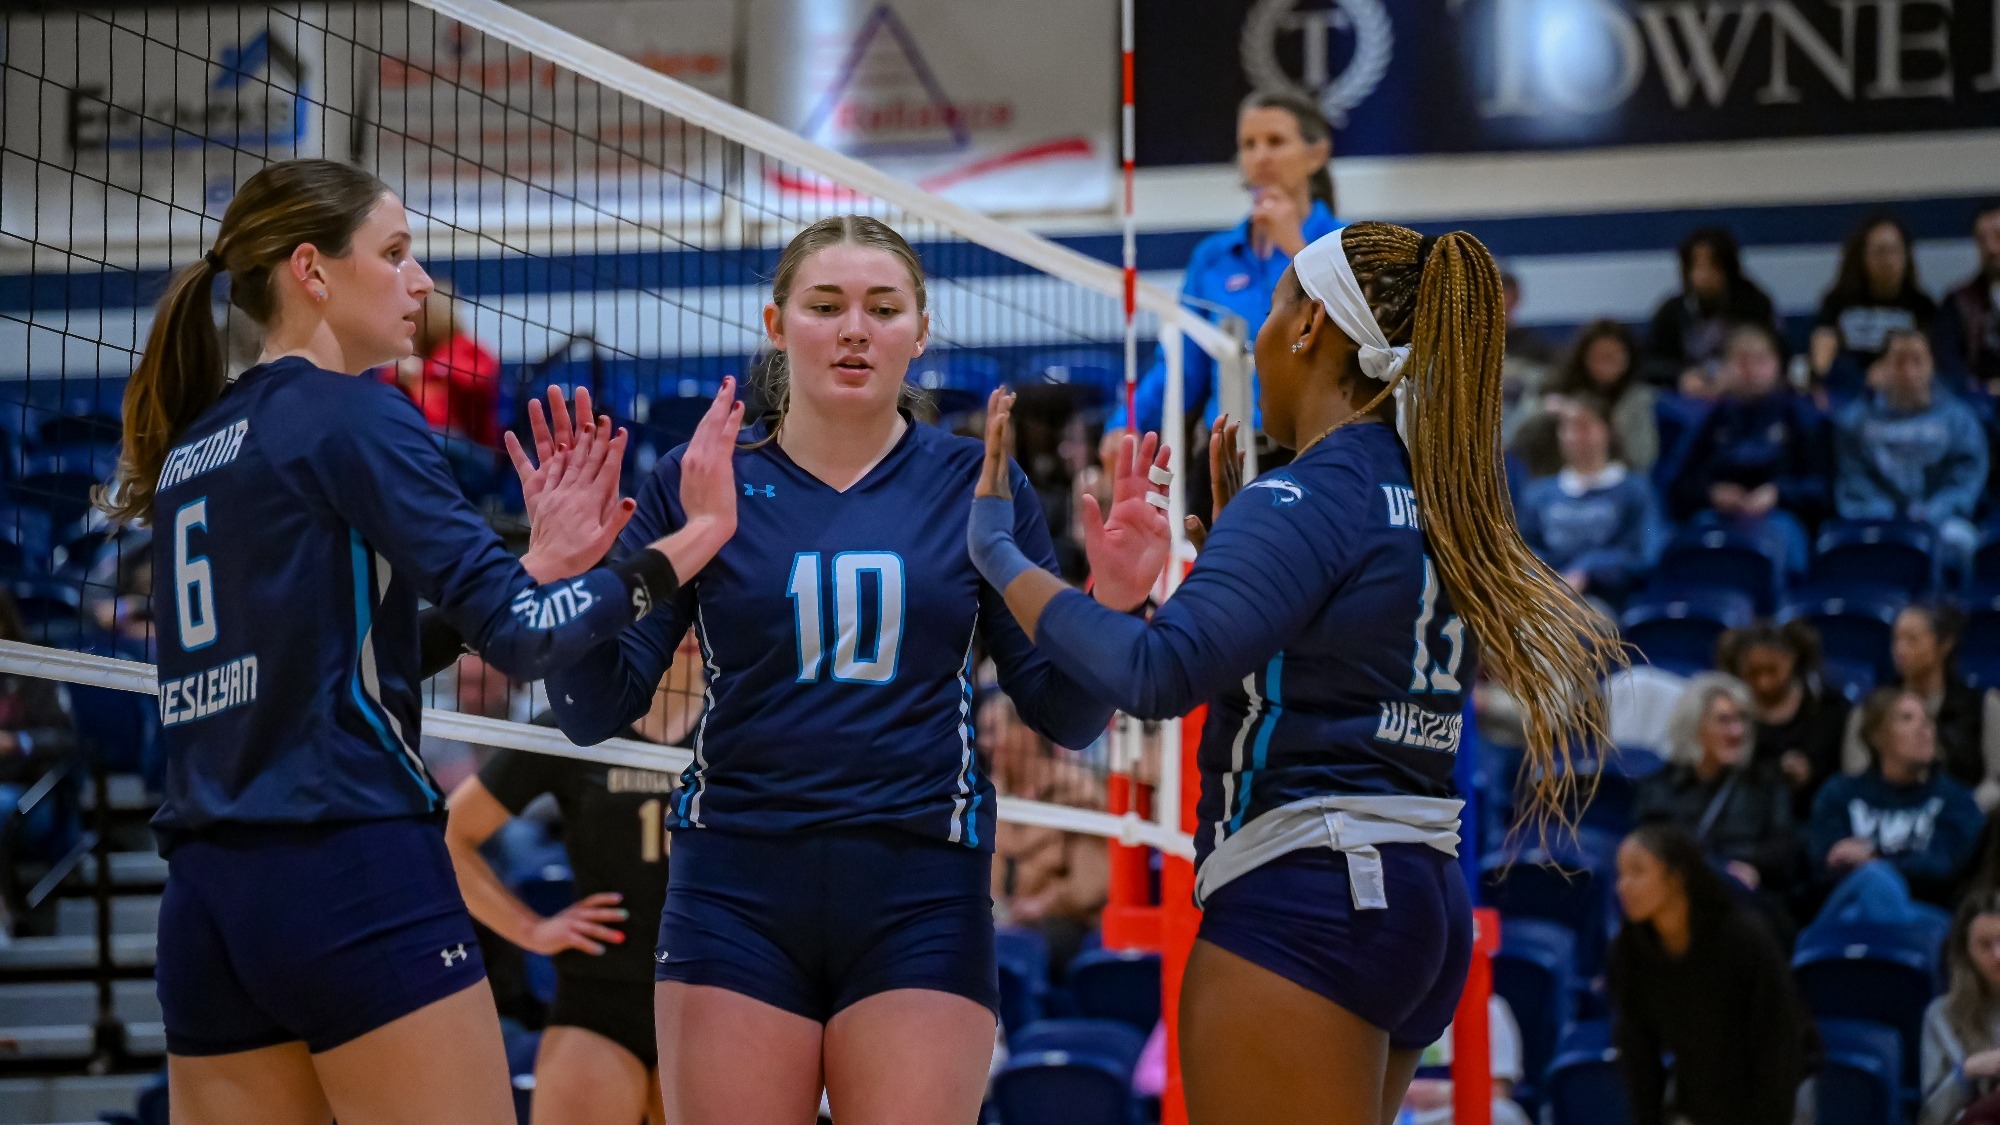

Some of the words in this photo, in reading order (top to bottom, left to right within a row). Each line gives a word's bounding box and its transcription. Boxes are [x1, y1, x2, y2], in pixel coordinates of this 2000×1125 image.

[1447, 0, 2000, 118] TOWNE
[174, 496, 218, 652] 6
[786, 550, 906, 686] 10
